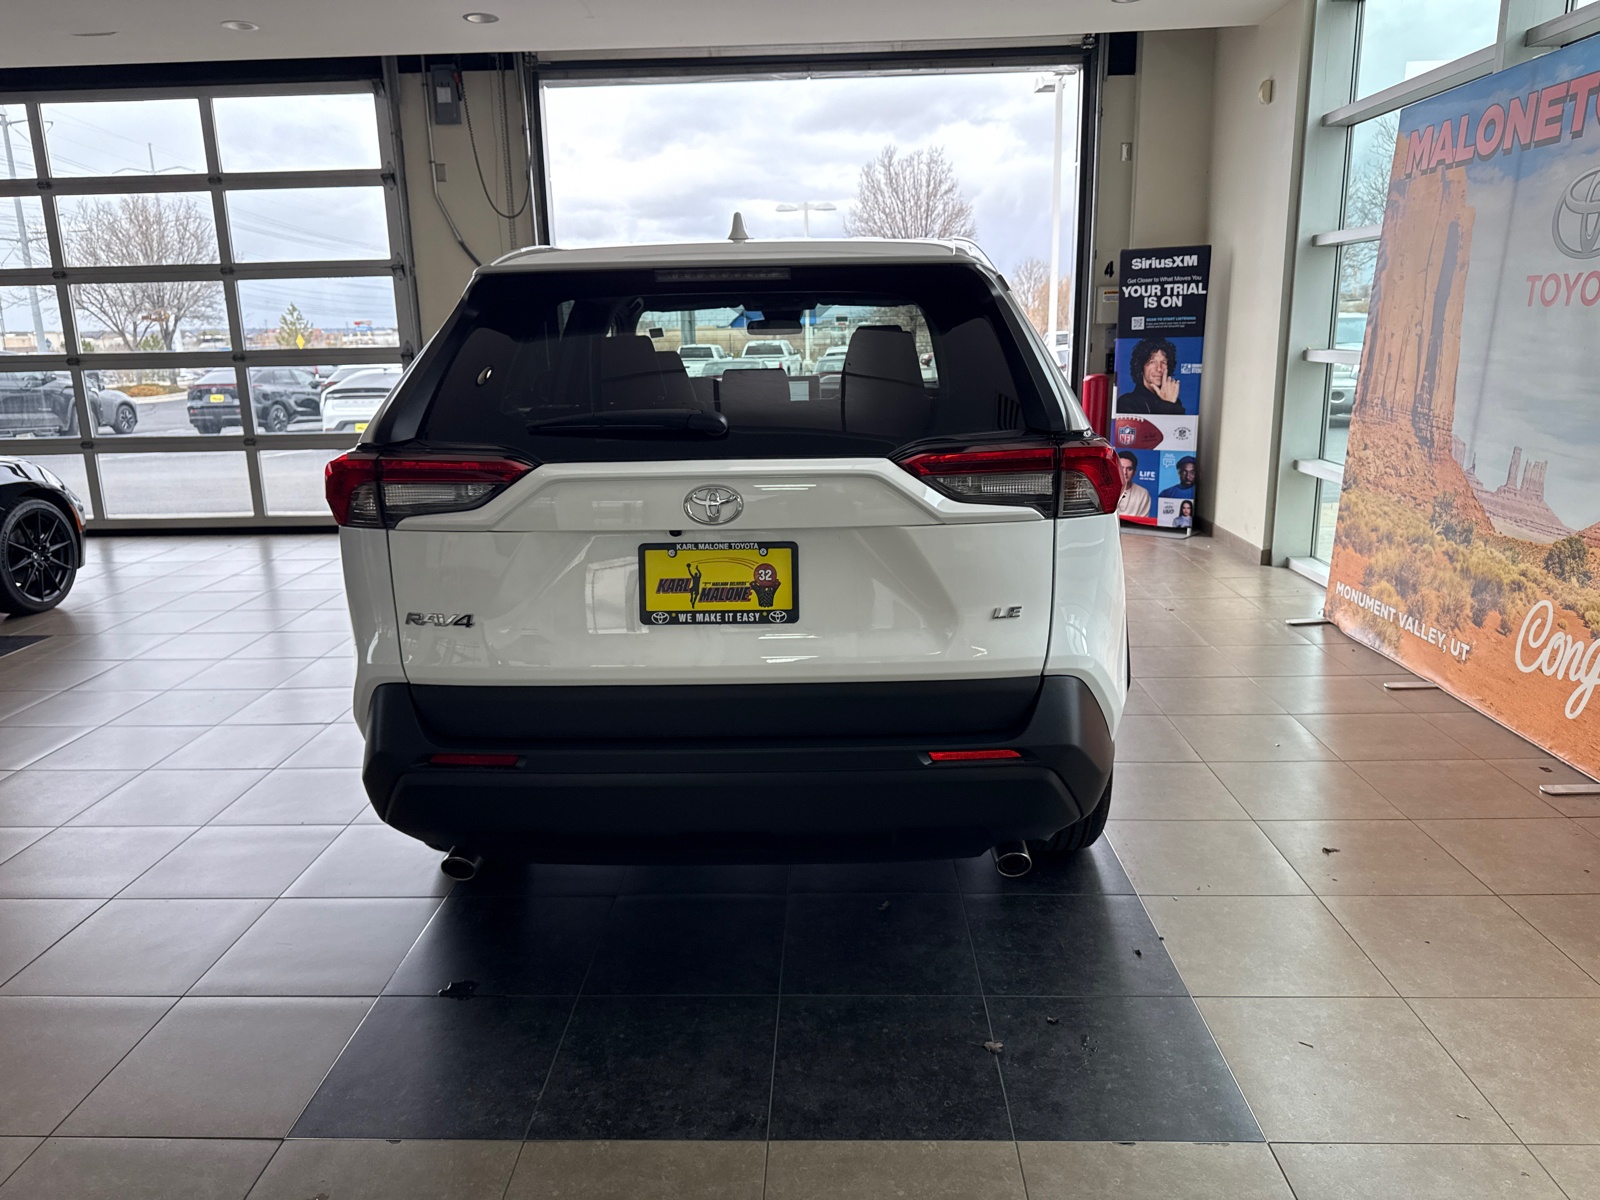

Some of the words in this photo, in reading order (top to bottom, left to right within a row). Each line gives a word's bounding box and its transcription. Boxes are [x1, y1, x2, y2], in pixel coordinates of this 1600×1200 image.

[1404, 69, 1600, 178] MALONET
[1104, 261, 1114, 278] 4
[1131, 255, 1198, 270] SiriusXM
[1122, 284, 1161, 298] YOUR
[1164, 282, 1207, 296] TRIAL
[1144, 296, 1158, 309] IS
[1160, 295, 1183, 308] ON
[1139, 470, 1156, 478] LIFE
[731, 542, 759, 550] TOYOTA
[758, 569, 772, 581] 32
[656, 578, 692, 594] KARL
[698, 586, 752, 603] MALONE
[405, 611, 475, 628] RAV4
[678, 613, 692, 623] WE
[696, 612, 722, 622] MAKE
[725, 612, 734, 622] IT
[736, 612, 760, 622] EASY
[992, 605, 1022, 619] LE
[1335, 581, 1397, 623] MONUMENT
[1398, 611, 1446, 654] VALLEY,
[1450, 637, 1470, 661] UT
